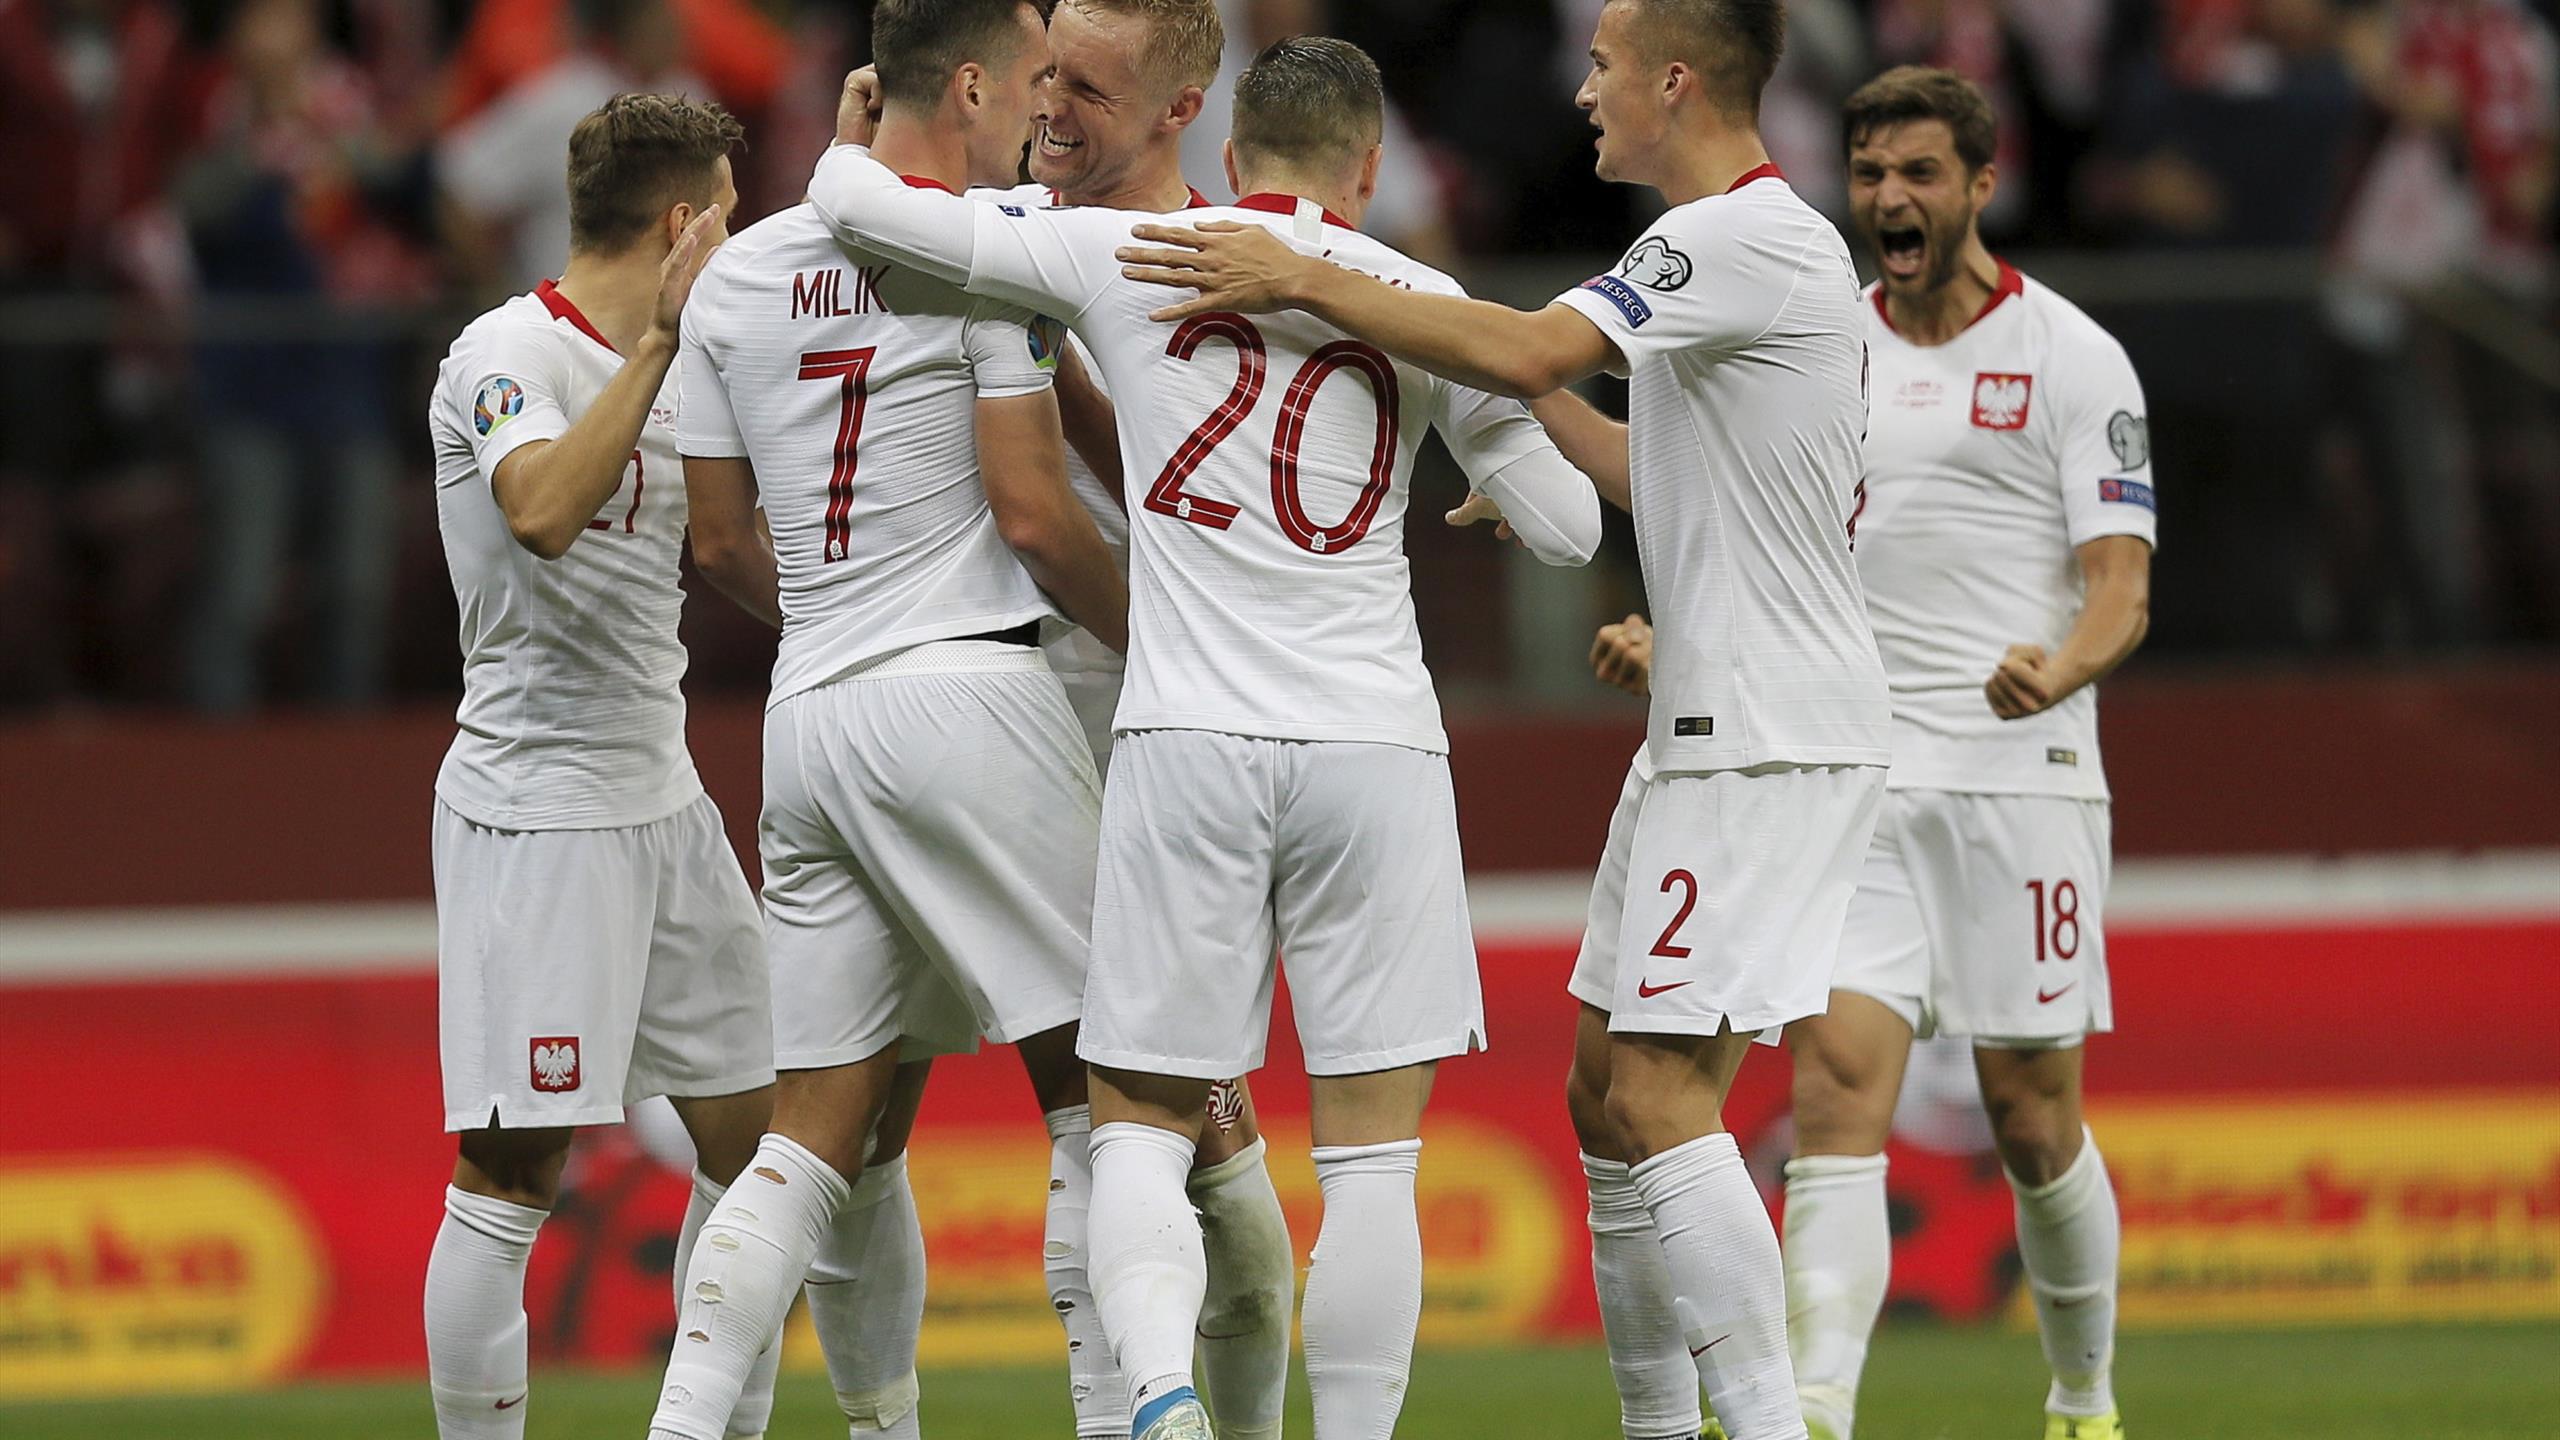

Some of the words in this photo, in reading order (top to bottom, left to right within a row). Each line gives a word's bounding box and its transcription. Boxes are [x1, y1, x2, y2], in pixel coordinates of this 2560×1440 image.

[791, 264, 892, 320] MILIK
[1598, 279, 1648, 323] RESPECT
[798, 345, 878, 563] 7
[1144, 311, 1400, 555] 20
[1648, 868, 1698, 958] 2
[2025, 879, 2079, 962] 18
